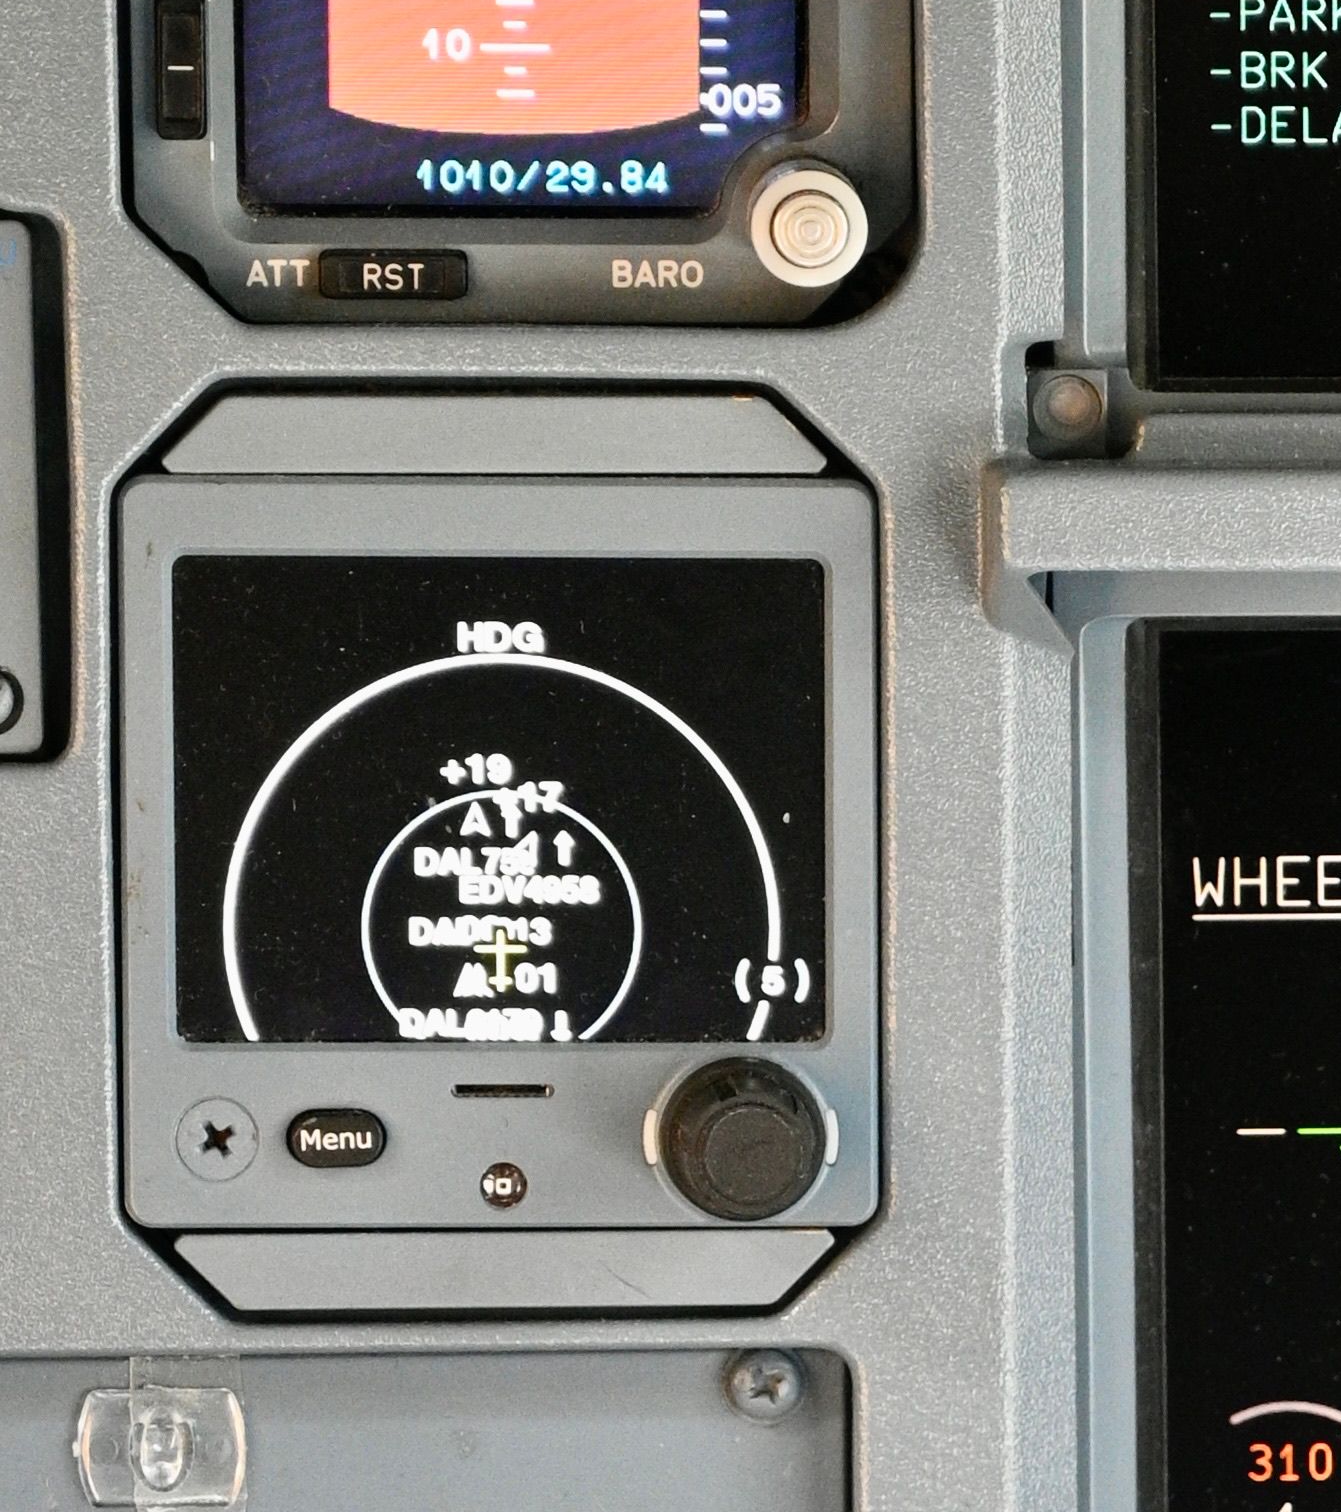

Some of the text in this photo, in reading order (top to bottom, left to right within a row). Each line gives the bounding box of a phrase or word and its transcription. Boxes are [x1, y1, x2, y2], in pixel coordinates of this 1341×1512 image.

[416, 159, 670, 195] 1010/29.84
[246, 255, 425, 291] ATT RST
[611, 259, 705, 288] BARO
[456, 621, 544, 653] HDG
[299, 1128, 373, 1152] Menu
[1247, 1442, 1333, 1482] 310
